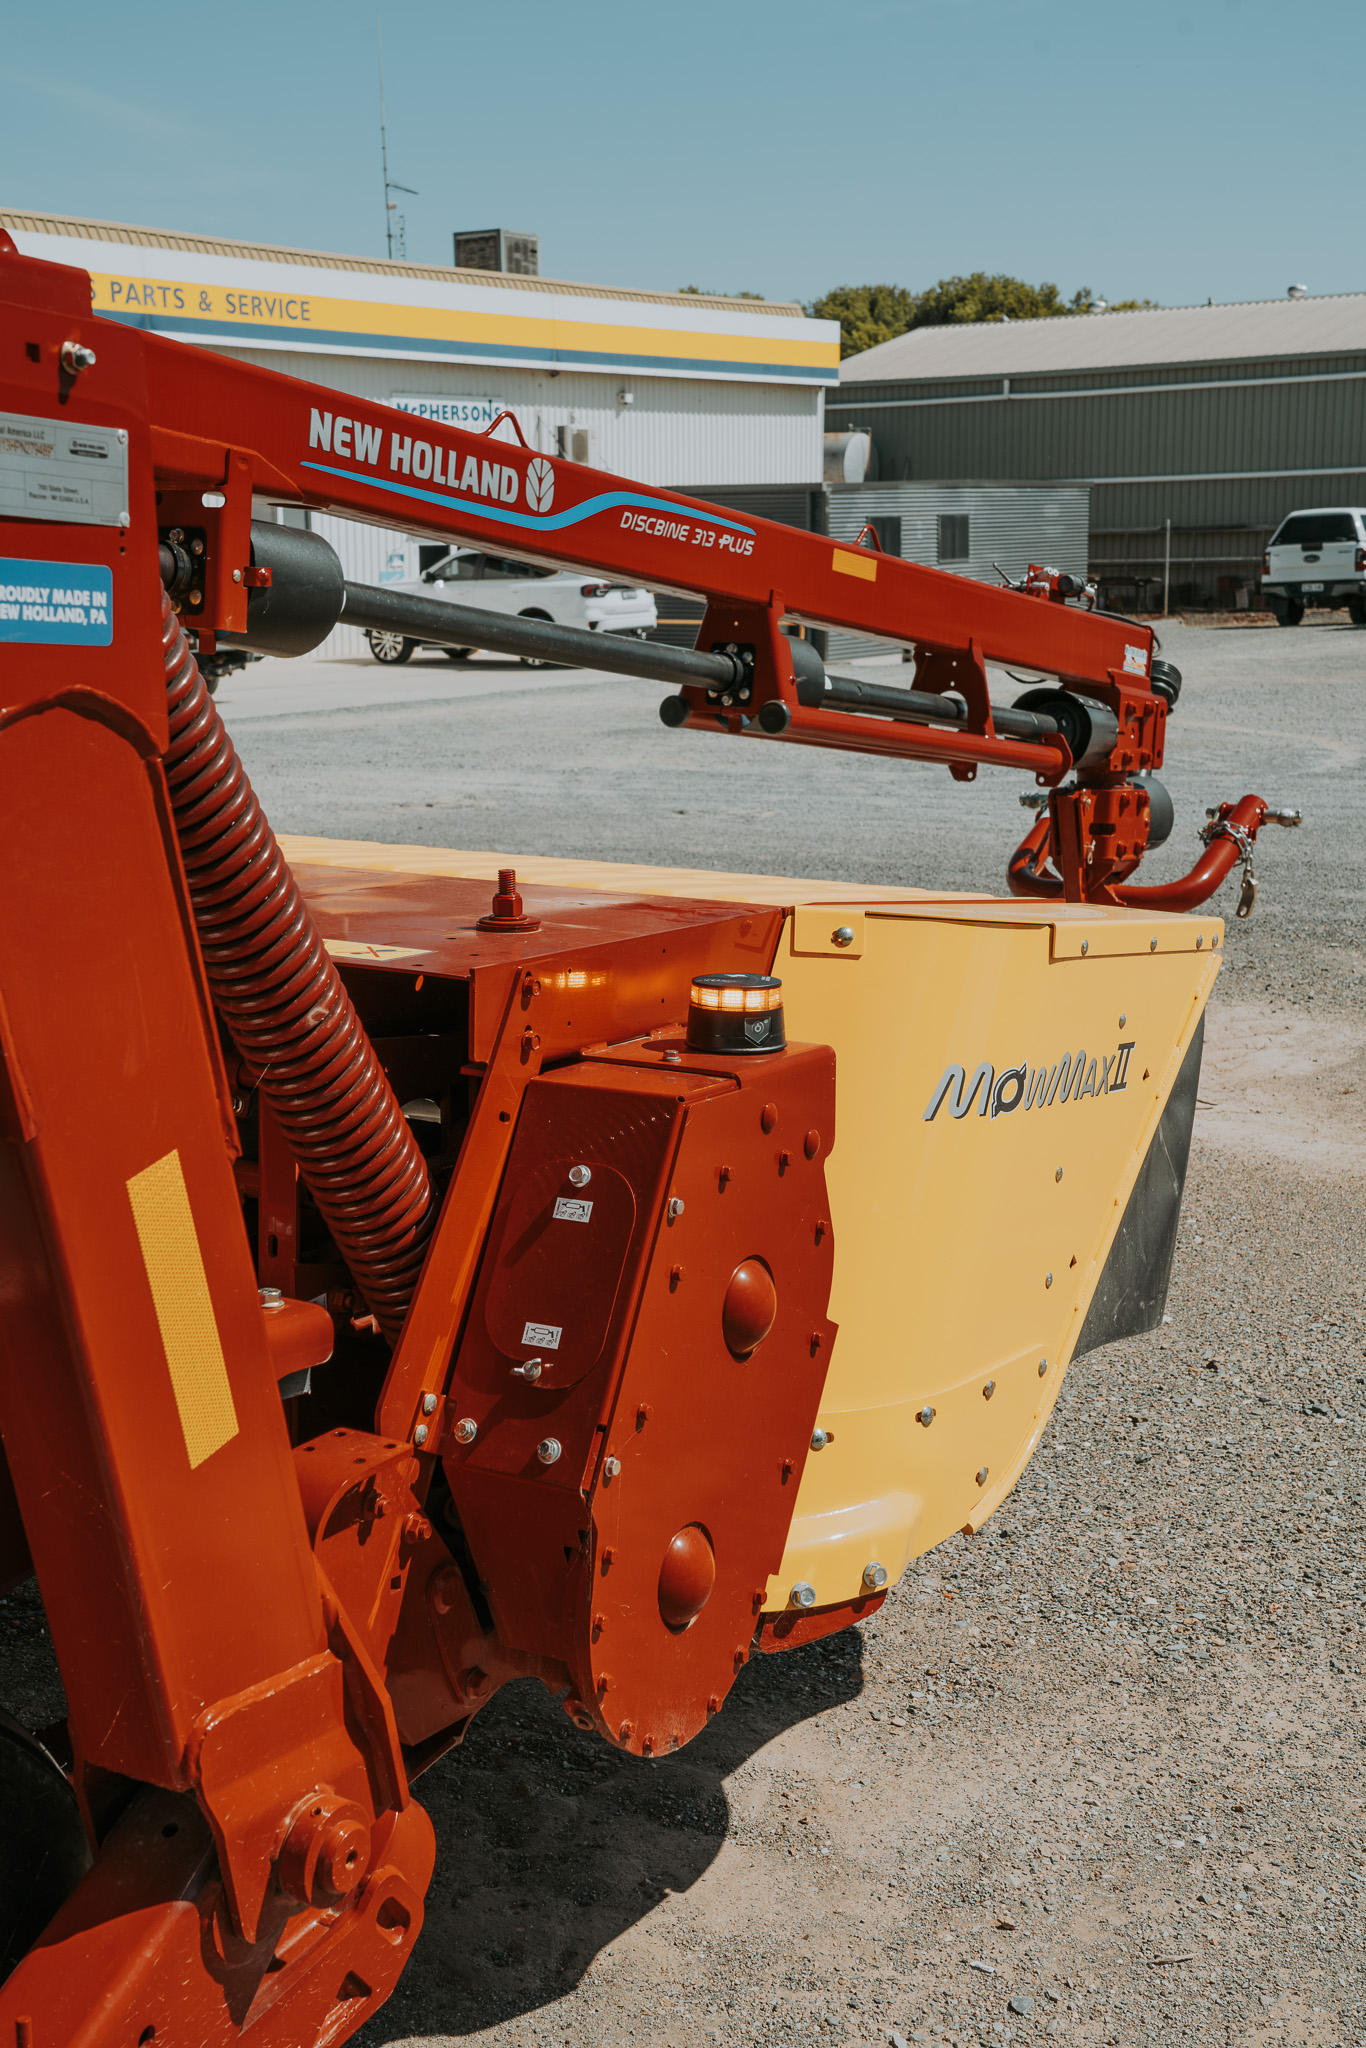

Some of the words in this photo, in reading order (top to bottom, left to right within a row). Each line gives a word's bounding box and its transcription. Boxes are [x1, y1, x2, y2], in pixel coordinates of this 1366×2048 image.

[110, 281, 185, 309] PARTS
[198, 290, 213, 312] &
[225, 293, 312, 321] SERVICE
[308, 407, 384, 467] NEW
[389, 432, 519, 505] HOLLAND
[620, 511, 690, 542] DISCBINE
[691, 528, 716, 548] 313
[22, 604, 88, 627] HOLLAND,
[90, 608, 108, 625] PA
[52, 588, 91, 606] MADE
[92, 591, 107, 608] IN
